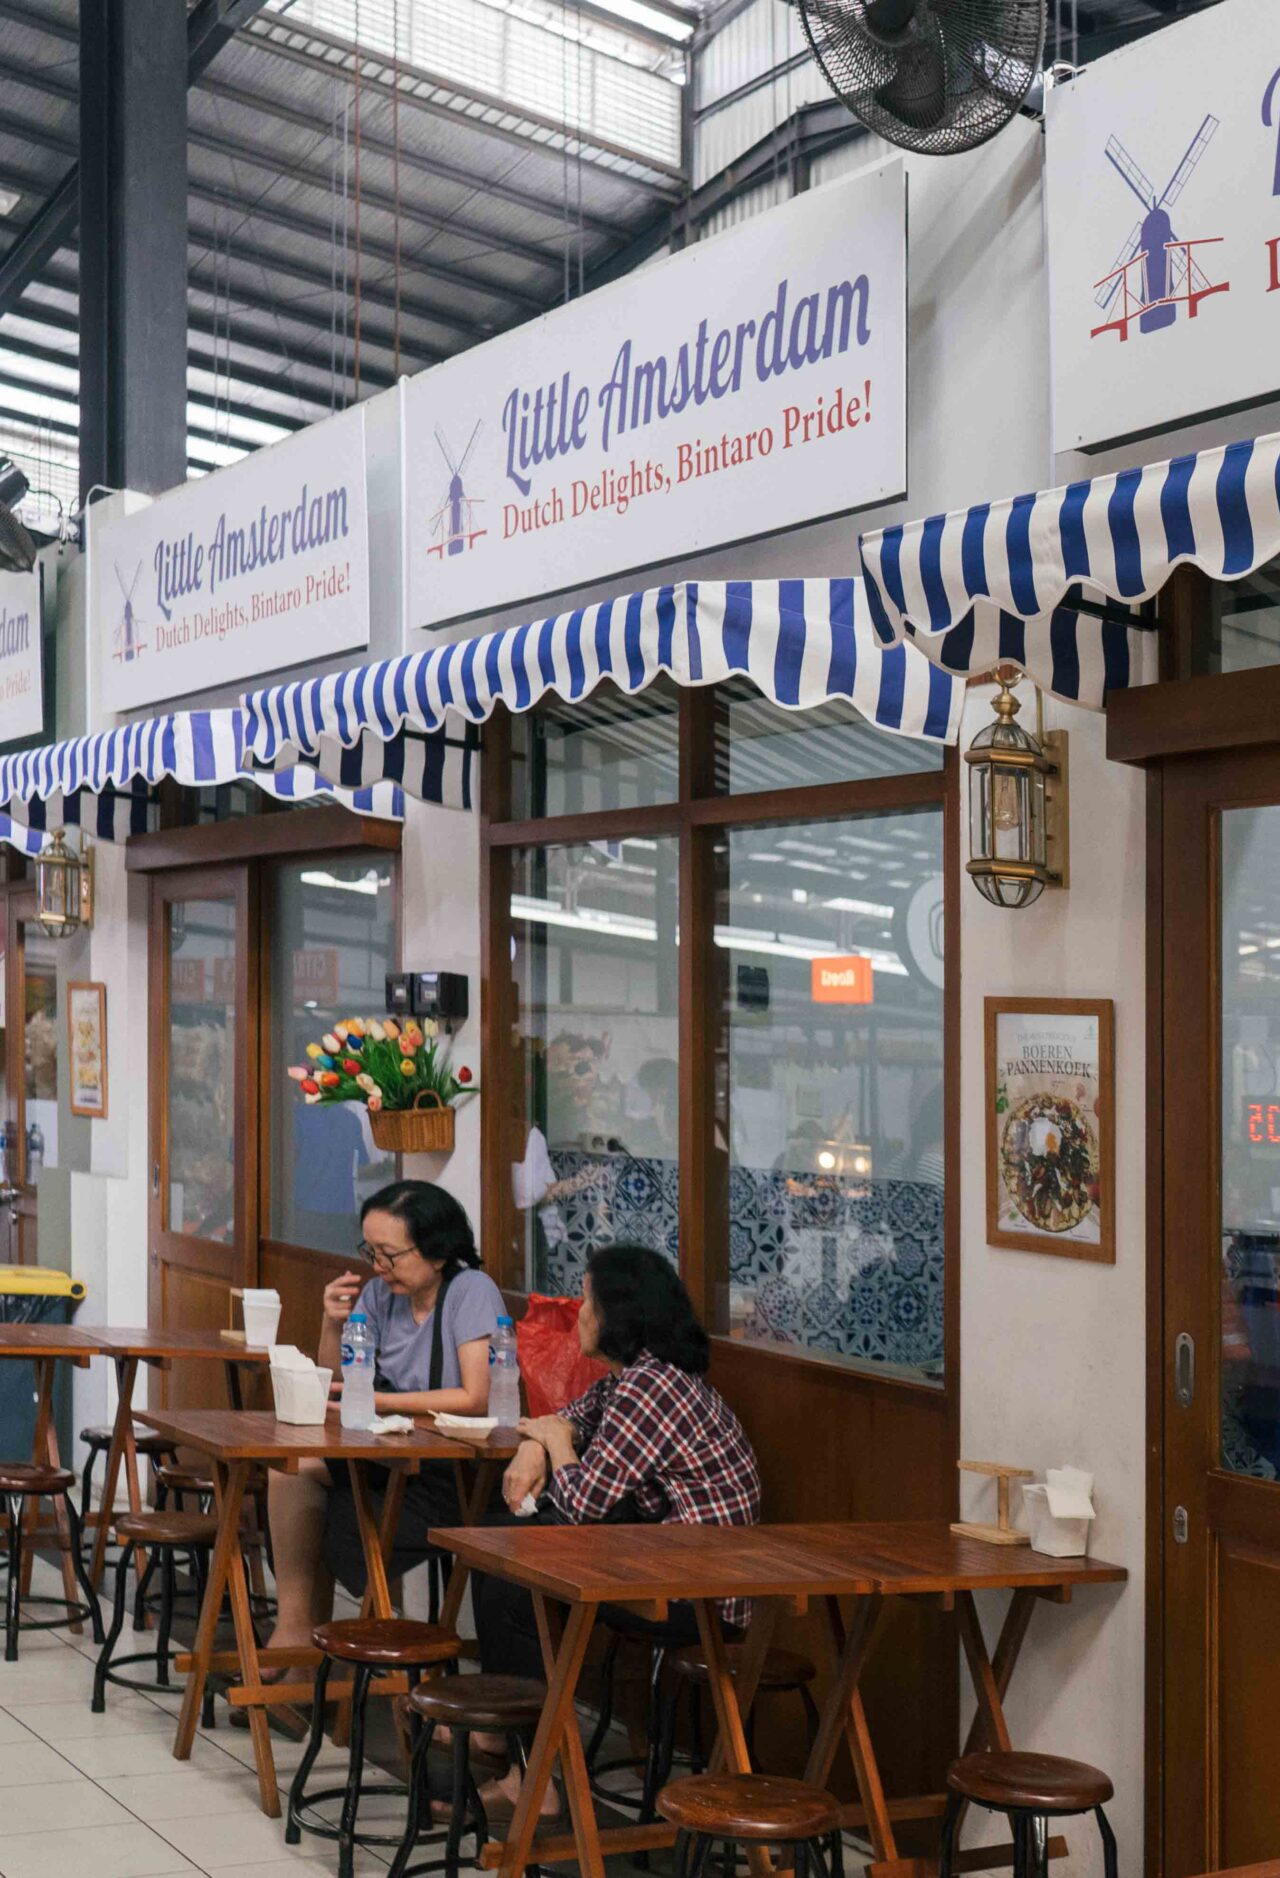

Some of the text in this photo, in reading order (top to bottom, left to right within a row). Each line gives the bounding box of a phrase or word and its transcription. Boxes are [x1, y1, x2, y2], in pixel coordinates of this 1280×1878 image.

[502, 274, 871, 496] Little Amsterdam
[503, 379, 872, 539] Dutch Delights, Bintaro Pride!
[154, 484, 348, 621] Little Amsterdam
[156, 562, 350, 652] Dutch Delights, Bintaro Pride!
[1006, 1059, 1091, 1079] PANNENKOEK
[1022, 1044, 1073, 1061] BOEREN
